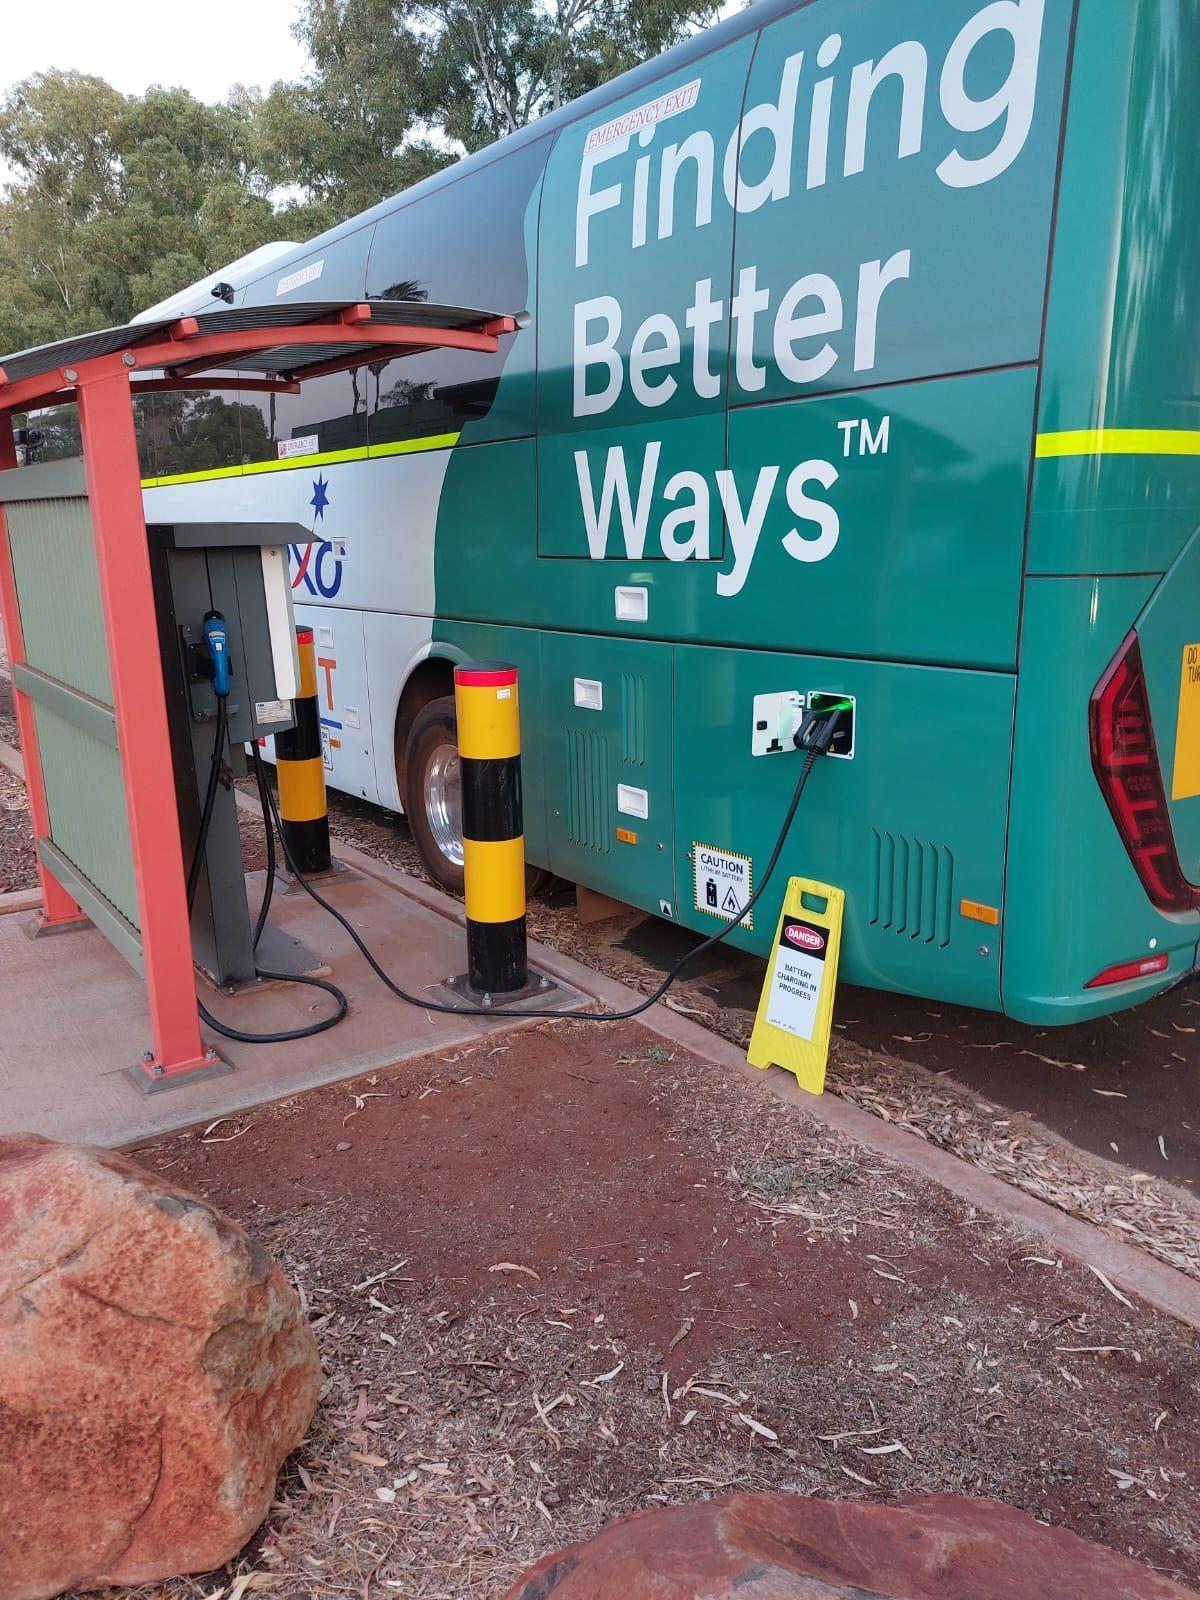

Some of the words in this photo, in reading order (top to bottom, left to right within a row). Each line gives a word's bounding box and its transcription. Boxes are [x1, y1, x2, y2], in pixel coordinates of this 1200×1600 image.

[588, 101, 664, 150] EMERGENCY
[663, 86, 697, 115] EXIT
[575, 0, 1045, 268] Finding
[574, 249, 911, 418] Better
[574, 441, 840, 596] Ways
[1187, 647, 1198, 664] DO
[700, 853, 744, 875] CAUTION
[700, 865, 720, 876] LITHIUM
[721, 871, 743, 883] BATTERY
[788, 927, 821, 947] DANGER
[776, 971, 809, 989] CHARGING
[809, 983, 817, 993] IN
[784, 963, 812, 980] BATTERY
[778, 982, 811, 1001] PROGRESS
